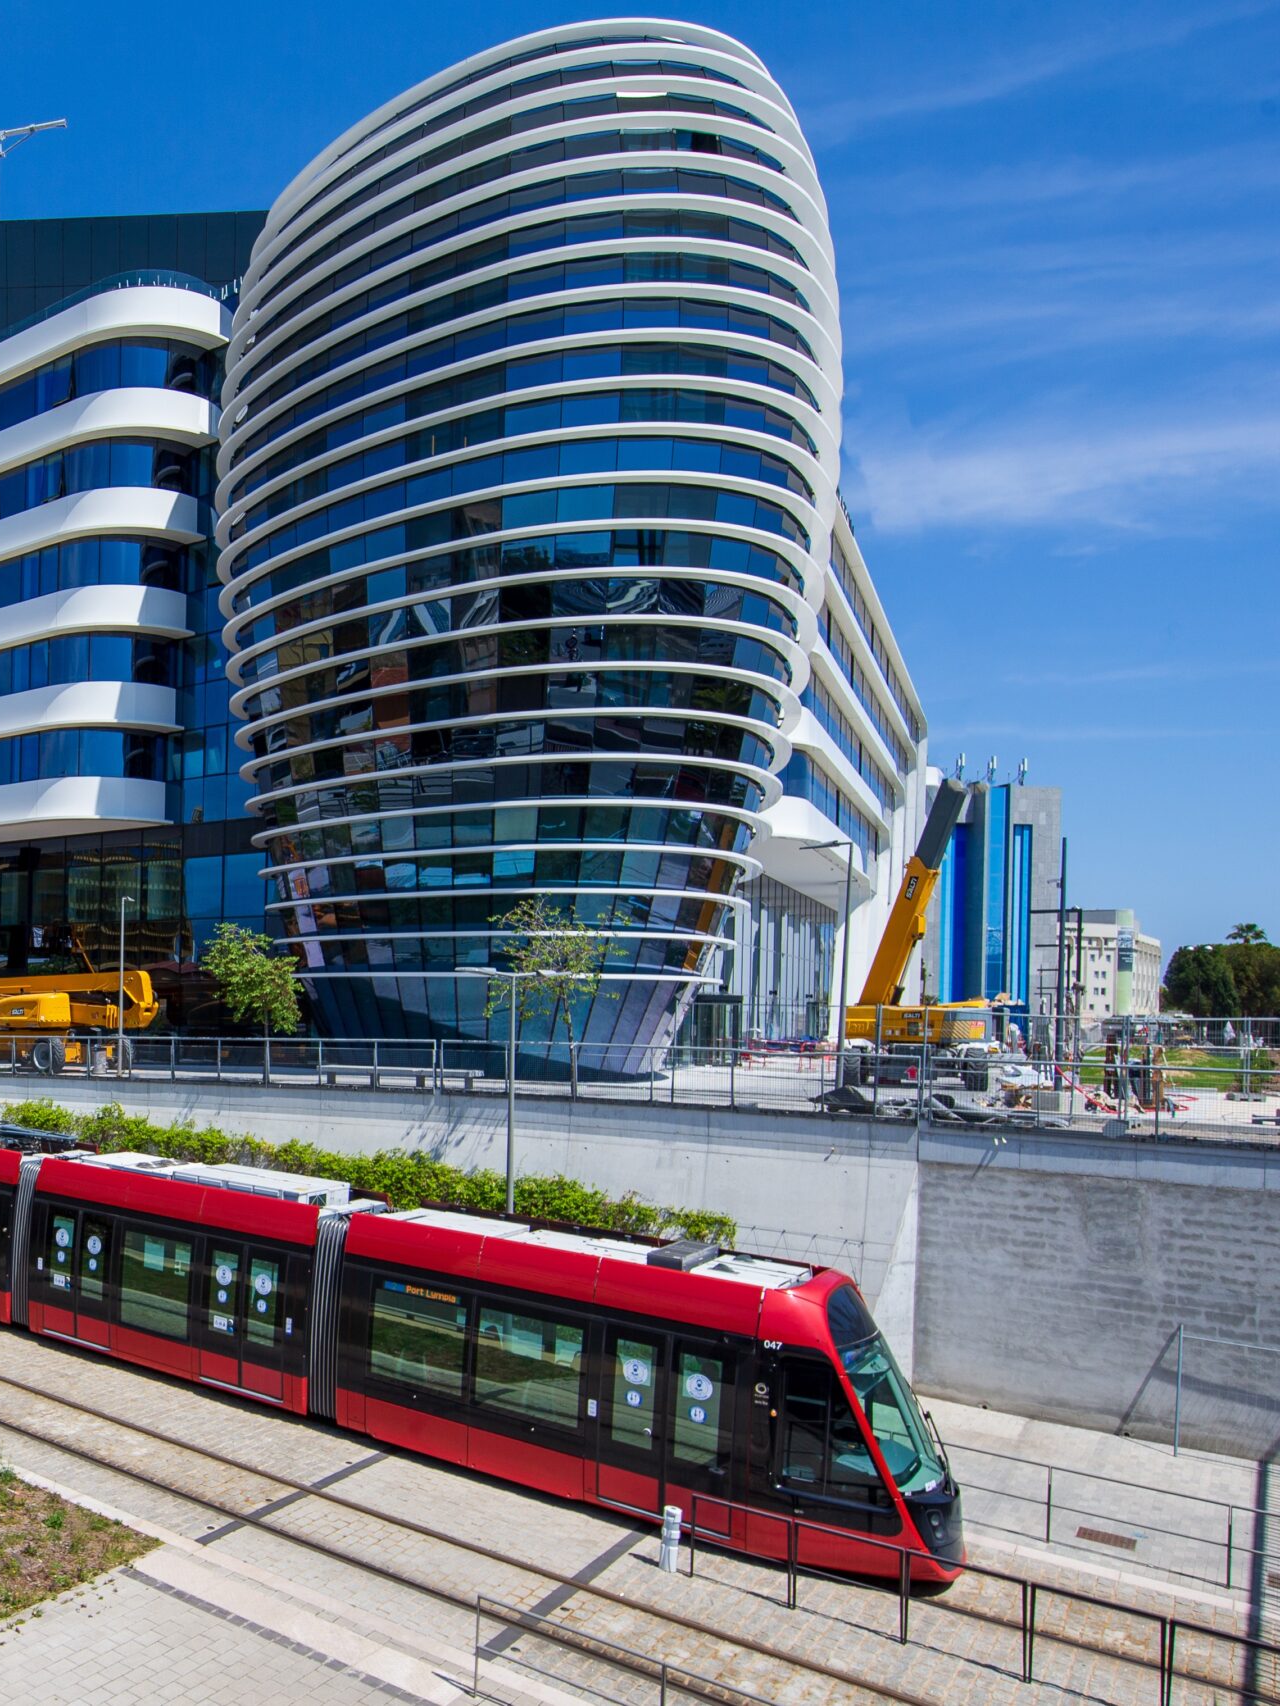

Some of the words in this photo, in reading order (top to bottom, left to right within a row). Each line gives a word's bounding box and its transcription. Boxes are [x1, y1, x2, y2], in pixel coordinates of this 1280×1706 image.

[405, 1284, 424, 1296] Port
[425, 1289, 456, 1304] Lympia
[763, 1339, 783, 1350] 047
